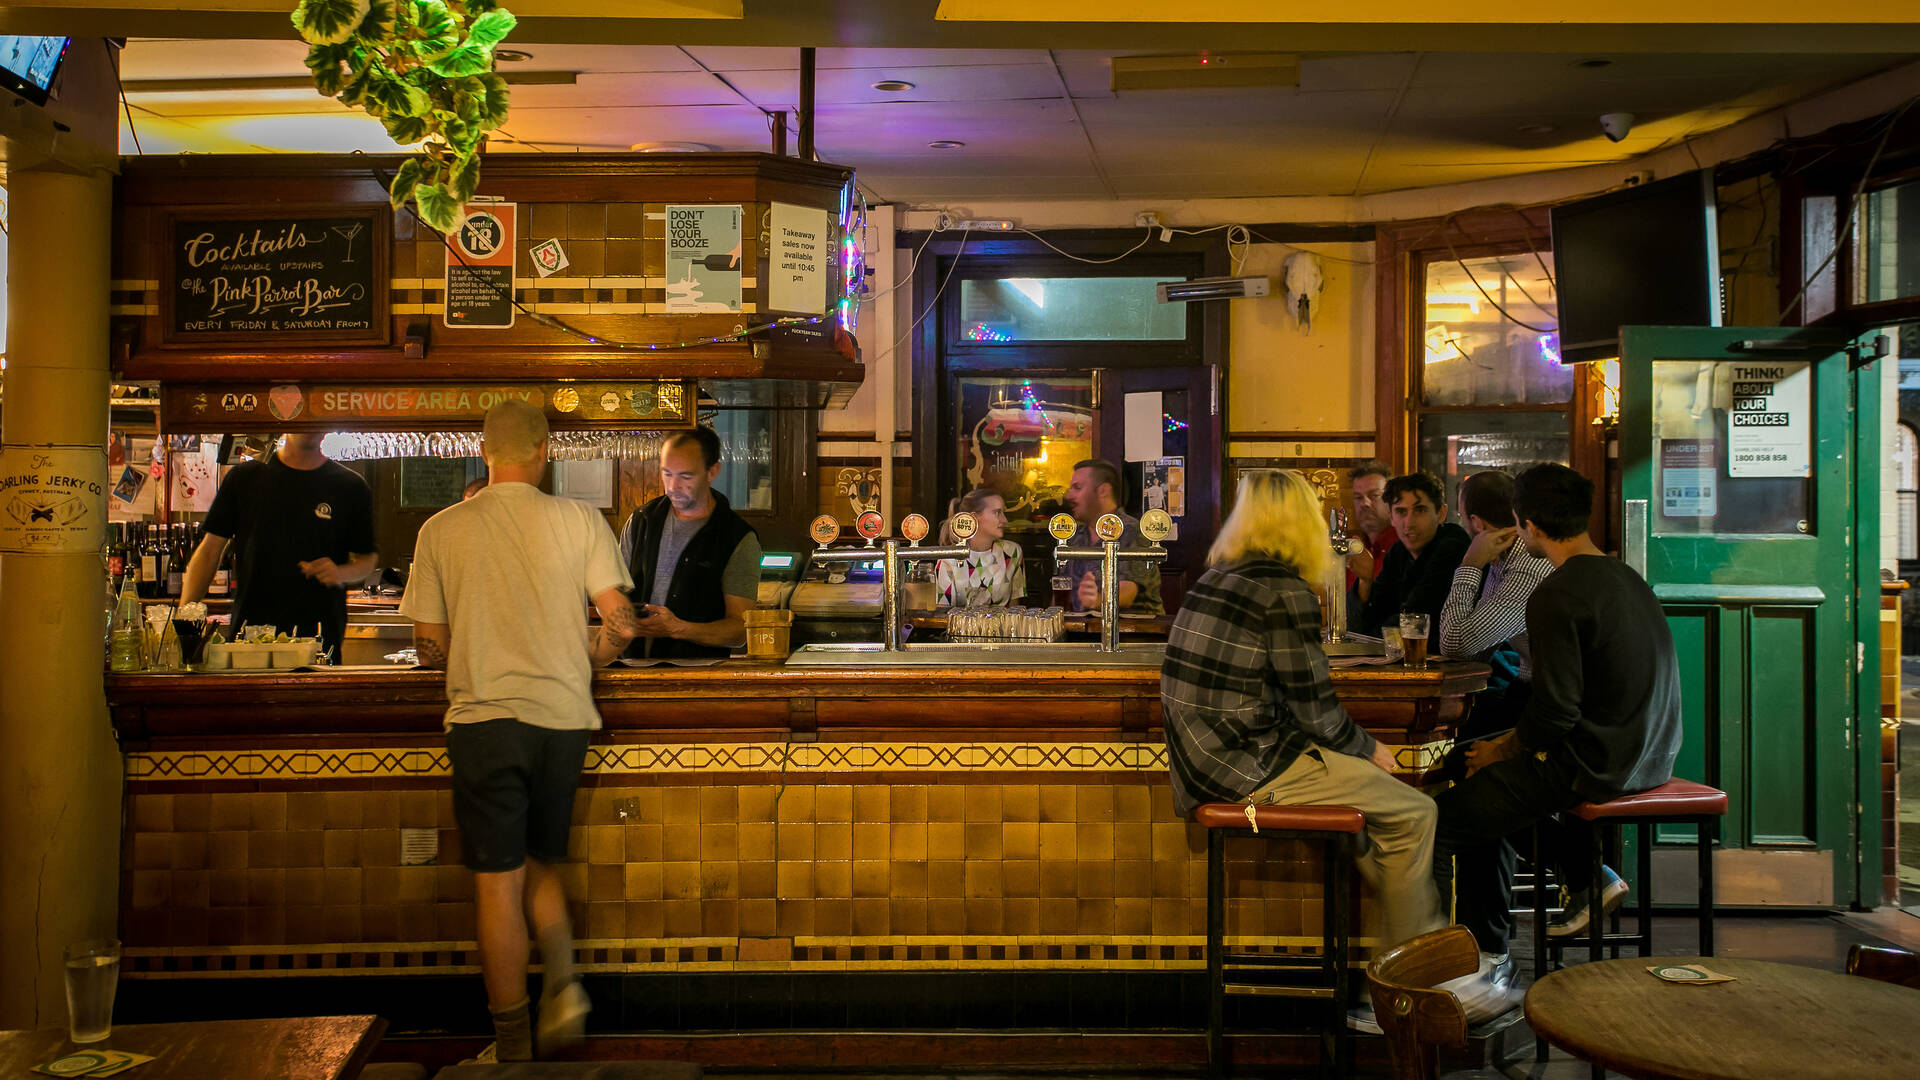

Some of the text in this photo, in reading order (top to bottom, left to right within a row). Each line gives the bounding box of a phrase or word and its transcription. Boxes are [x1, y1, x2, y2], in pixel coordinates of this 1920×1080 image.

[670, 210, 705, 220] DON'T
[670, 220, 700, 229] LOSE
[670, 229, 701, 238] YOUR
[782, 228, 816, 240] Takeaway
[467, 228, 492, 250] 18
[670, 239, 709, 248] BOOZE
[184, 223, 326, 267] Cocktails
[782, 240, 815, 250] sales now
[784, 251, 813, 261] available
[221, 261, 324, 271] AVAILABLE UPSTAIRS
[781, 262, 815, 272] until 10:45
[792, 274, 804, 282] pm
[209, 276, 256, 311] Pink
[248, 275, 303, 315] Parrot
[290, 278, 364, 317] Bar
[185, 320, 222, 330] EVERY
[231, 320, 266, 330] FRIDAY
[284, 320, 332, 329] SATURDAY
[336, 321, 361, 329] FROM
[1734, 367, 1784, 379] THINK!
[1735, 384, 1773, 394] ABOUT
[323, 392, 410, 410] SERVICE
[415, 392, 471, 410] AREA
[1735, 399, 1765, 410] YOUR
[1734, 414, 1787, 425] CHOICES
[1665, 444, 1697, 452] UNDER
[31, 454, 54, 469] The
[46, 475, 86, 489] JERKY
